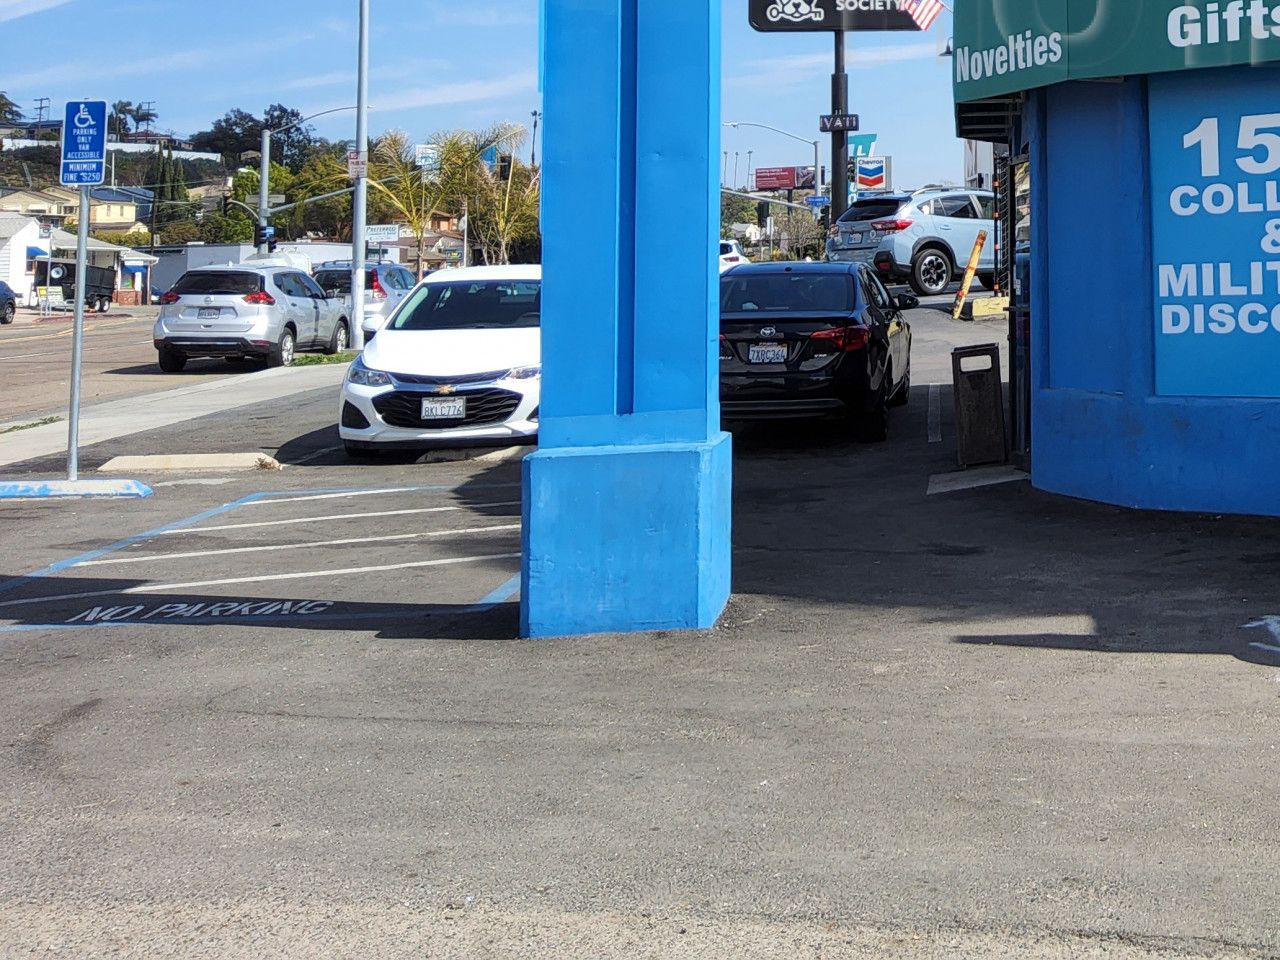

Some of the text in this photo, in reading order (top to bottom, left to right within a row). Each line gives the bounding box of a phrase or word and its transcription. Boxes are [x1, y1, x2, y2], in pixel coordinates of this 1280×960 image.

[956, 30, 1063, 83] Novelties
[77, 136, 92, 144] ONLY
[67, 151, 100, 159] ACCESSIBLE
[69, 163, 97, 171] MINIMUM
[63, 172, 78, 181] FINE
[65, 600, 334, 623] NO PARKING
